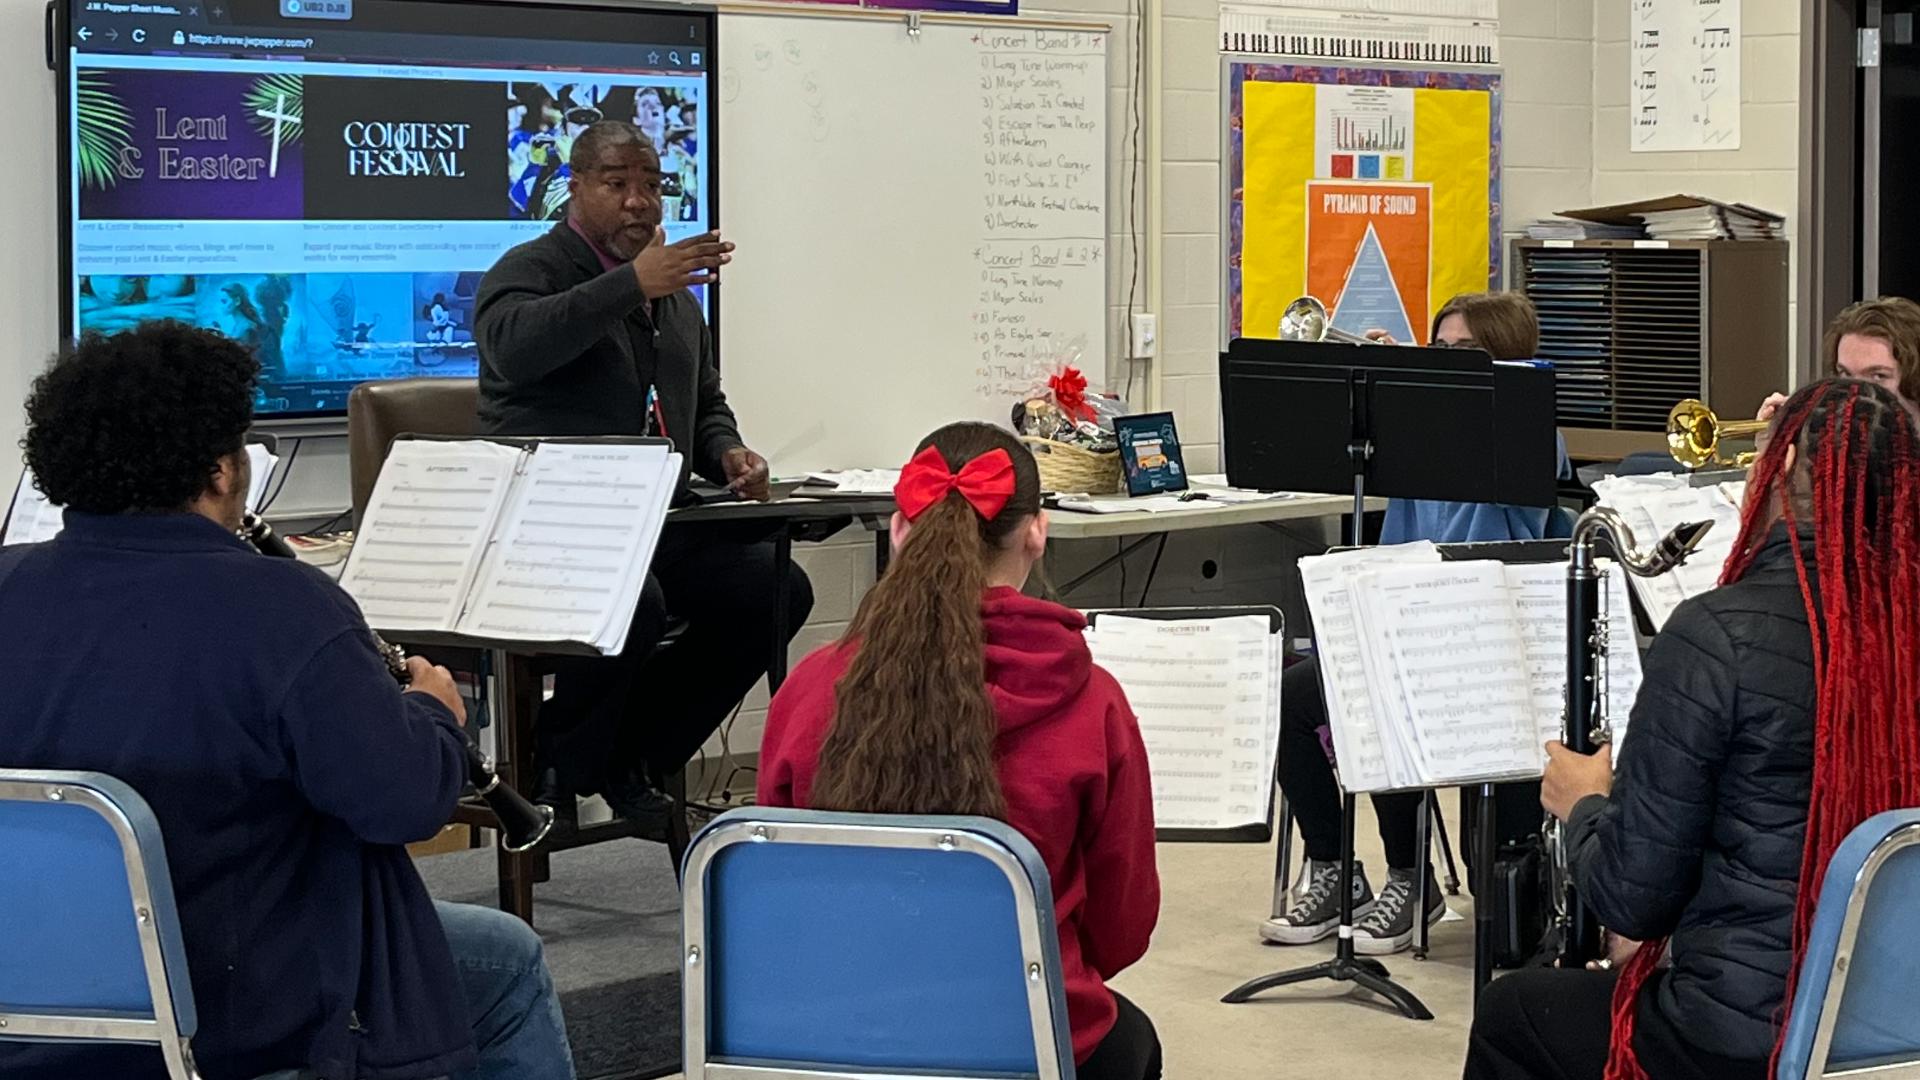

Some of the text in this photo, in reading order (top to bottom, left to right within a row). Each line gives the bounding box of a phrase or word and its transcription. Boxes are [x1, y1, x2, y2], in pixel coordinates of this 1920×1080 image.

[980, 27, 1027, 48] Concert
[1035, 29, 1069, 50] Band
[993, 55, 1016, 76] Long
[996, 75, 1026, 92] Major
[155, 107, 228, 141] Lent
[117, 147, 267, 181] & Easter
[1323, 193, 1417, 215] PYRAMID OF SOUND
[982, 244, 1024, 266] Concert
[1031, 245, 1060, 265] Band
